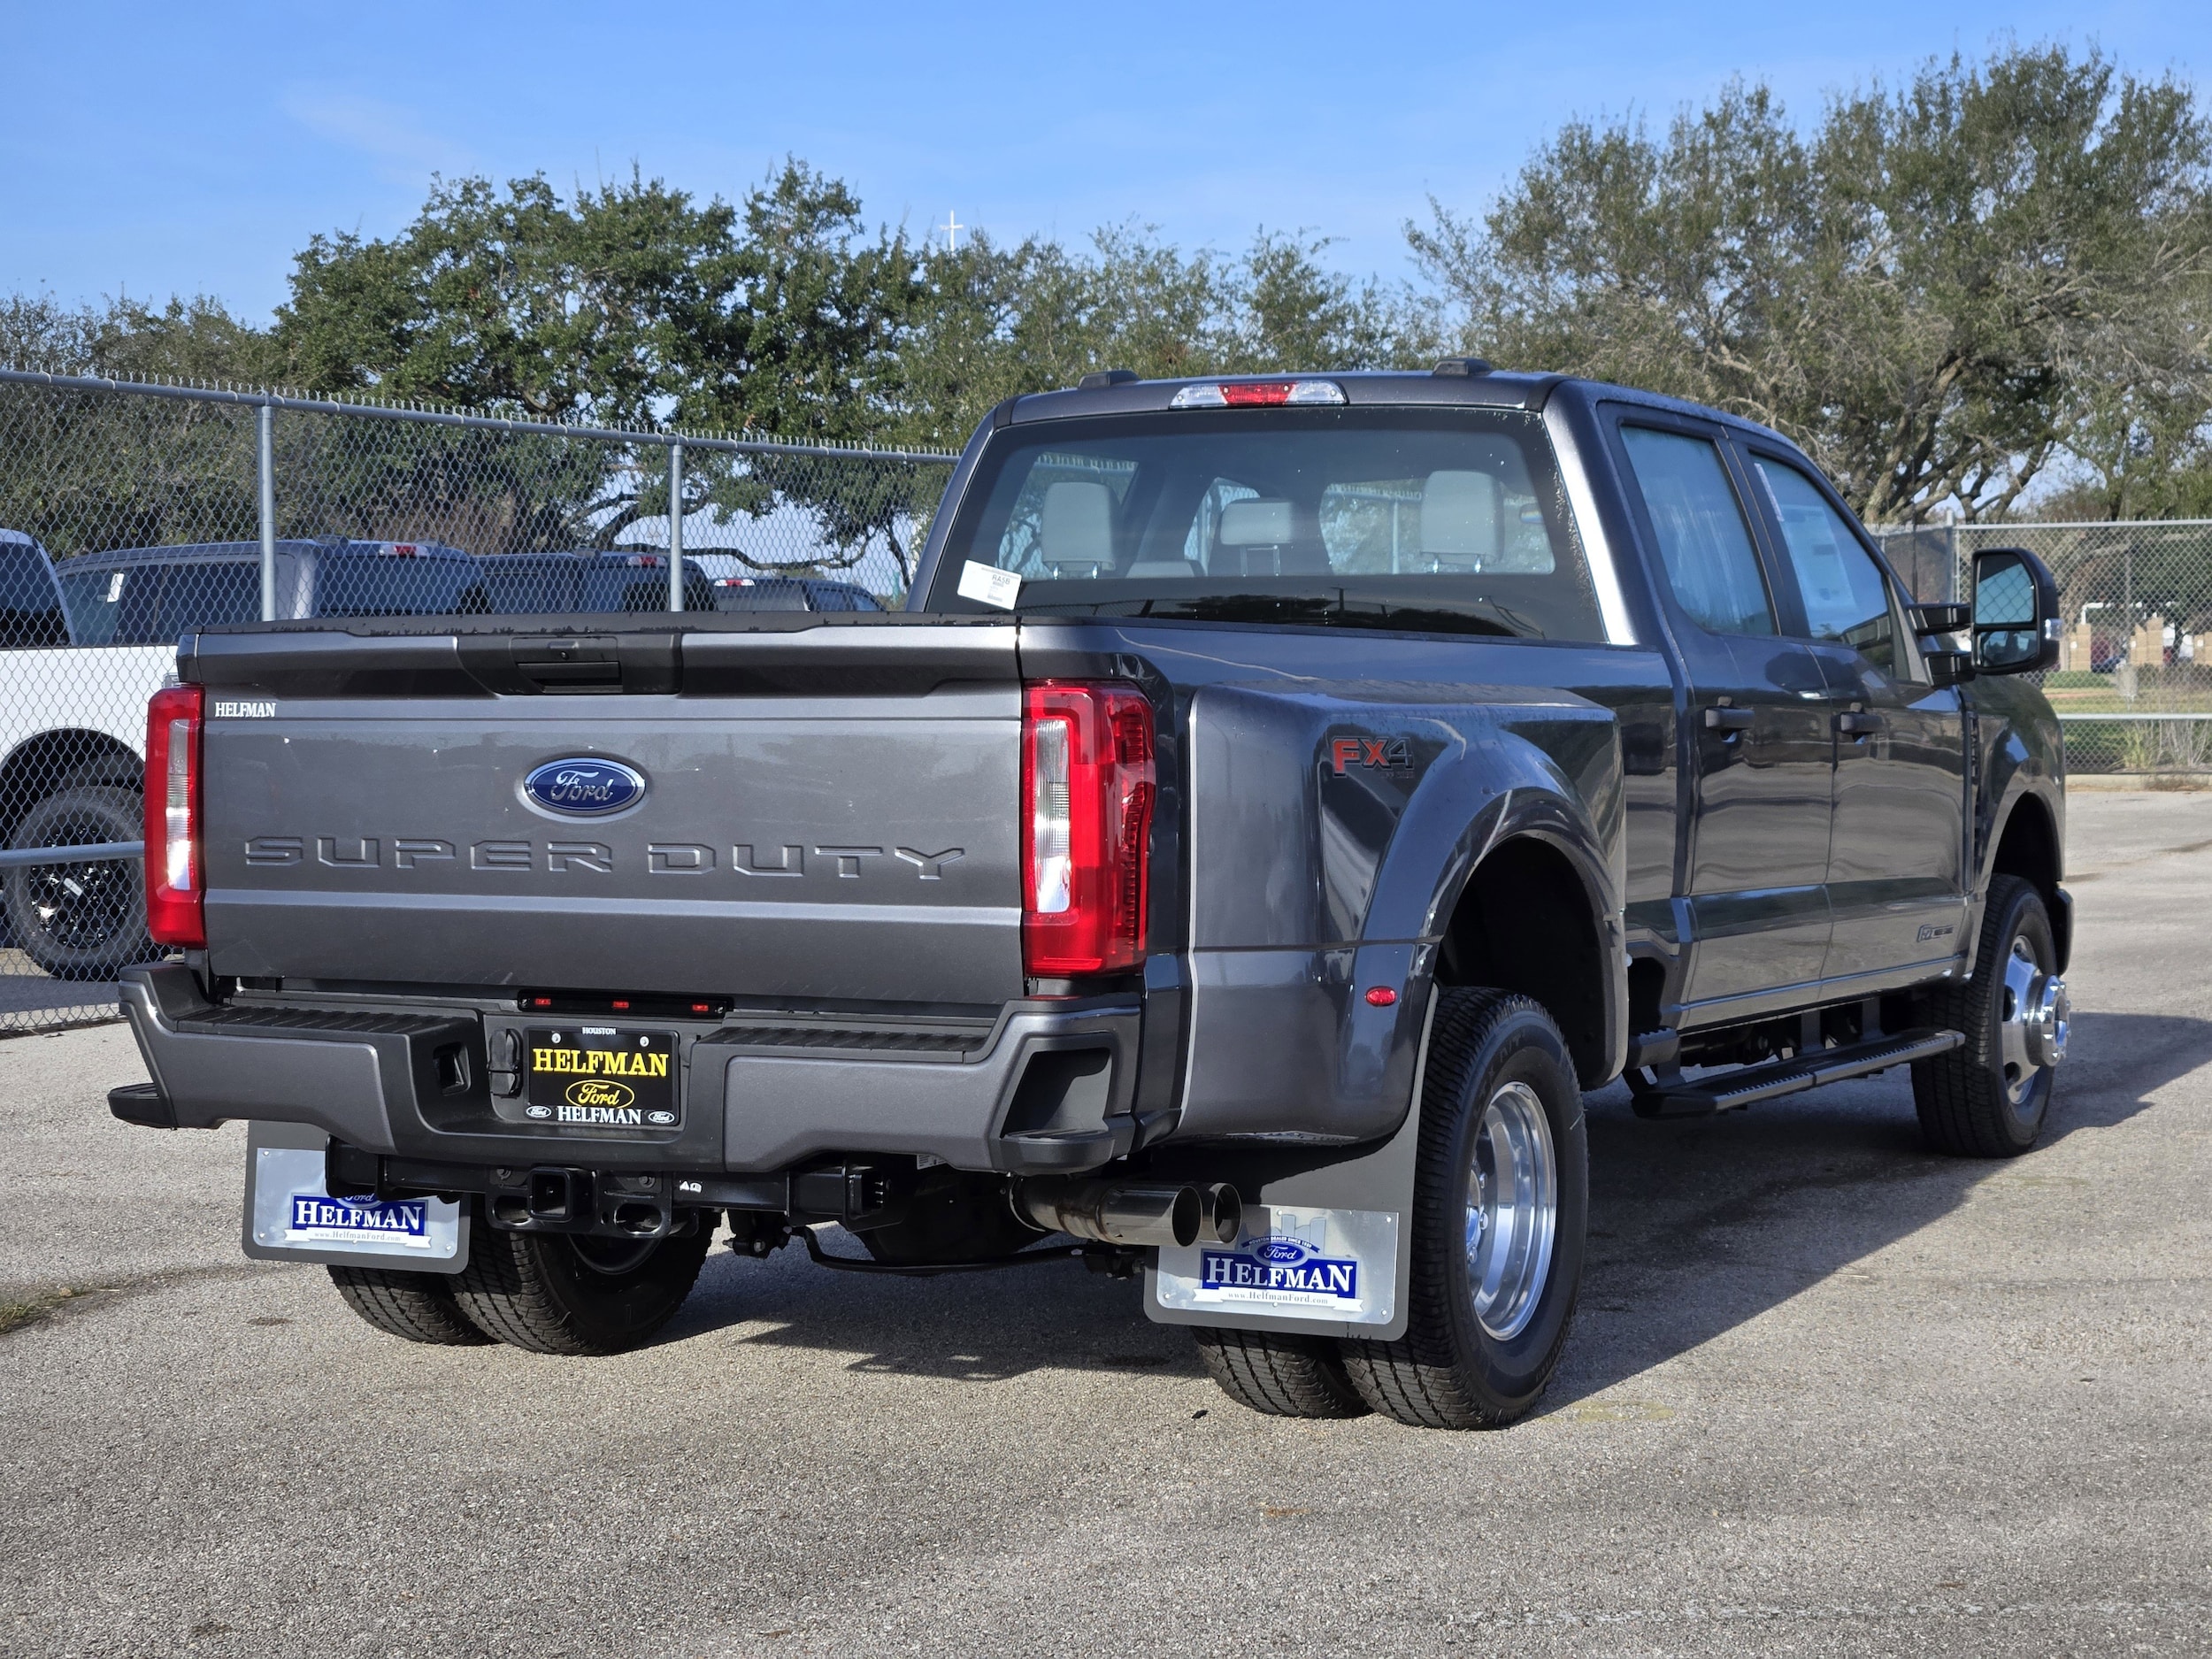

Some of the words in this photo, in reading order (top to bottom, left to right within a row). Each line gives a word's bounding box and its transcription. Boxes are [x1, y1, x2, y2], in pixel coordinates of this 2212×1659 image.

[215, 702, 276, 718] HELFMAN
[1332, 736, 1414, 778] FX4
[550, 770, 614, 802] Ford
[245, 836, 612, 873] SUPER
[648, 842, 965, 880] DUTY
[582, 1026, 617, 1035] HOUSTON
[533, 1048, 669, 1077] HELFMAN
[578, 1082, 620, 1105] Ford
[557, 1106, 642, 1125] HELFMAN
[296, 1200, 423, 1231] HELFMAN
[314, 1231, 401, 1241] www.HelfmanFord.com
[1263, 1245, 1297, 1260] Ford
[1207, 1256, 1354, 1293] HELFMAN
[1228, 1291, 1328, 1304] www.HelfmanFord.com
